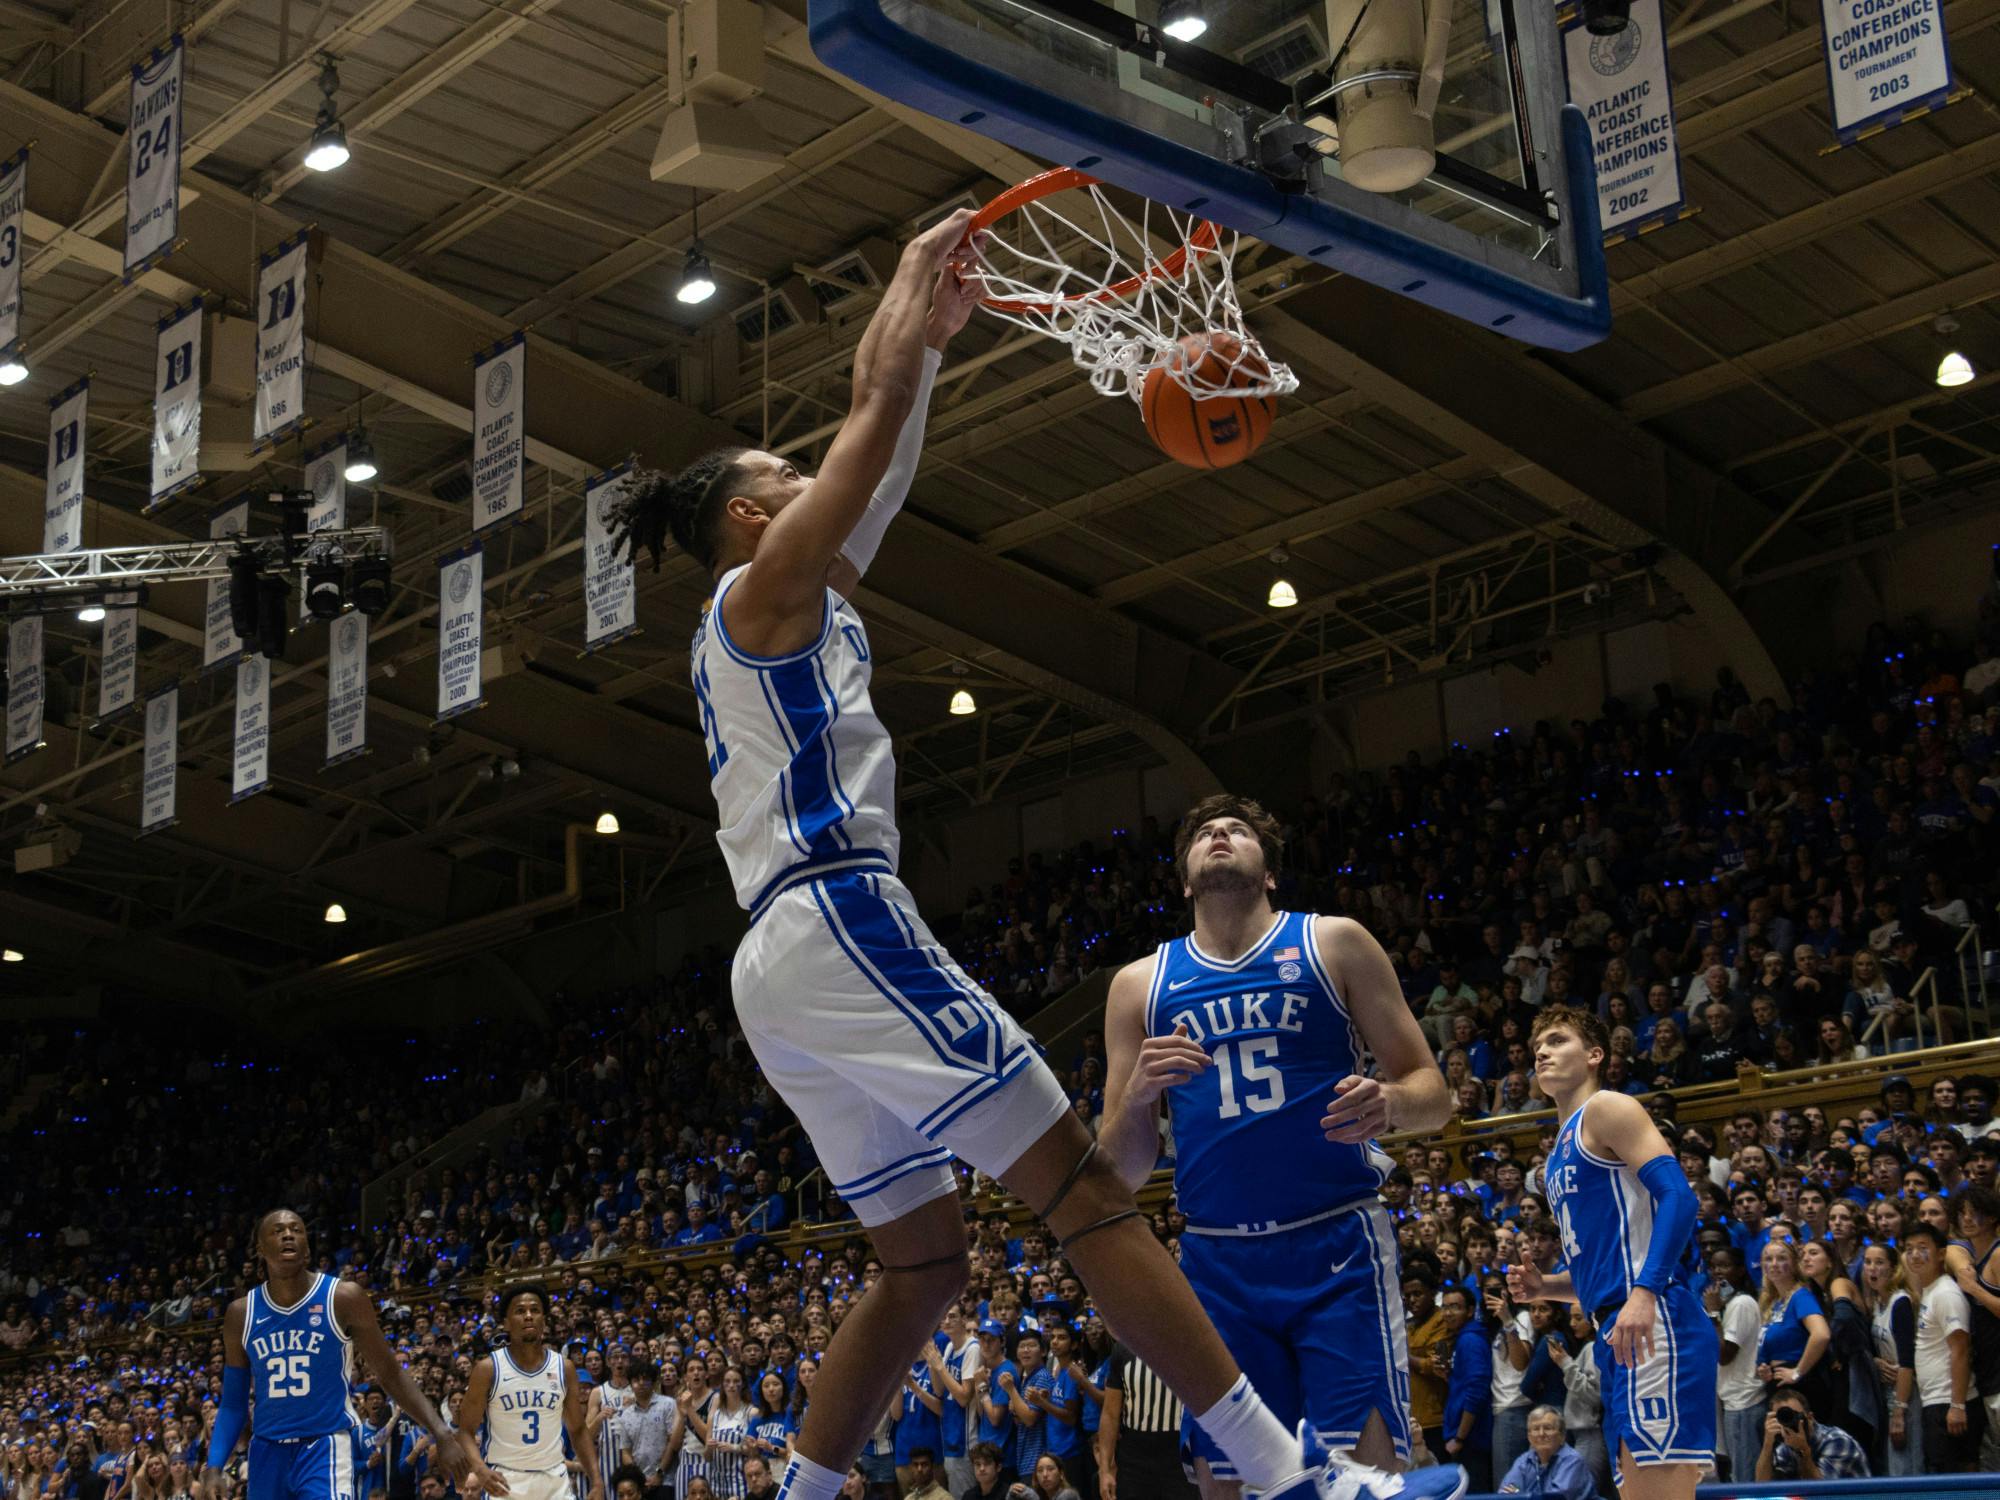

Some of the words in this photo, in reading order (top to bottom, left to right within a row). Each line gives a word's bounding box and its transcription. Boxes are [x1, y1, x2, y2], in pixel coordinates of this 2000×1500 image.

[1852, 0, 1902, 19] COAS
[1831, 0, 1933, 51] CONFERENCE
[1839, 18, 1932, 70] CHAMPIONS
[1854, 47, 1917, 81] TOURNAMENT
[1587, 80, 1651, 120] ATLANTIC
[1869, 74, 1910, 102] 2003
[1598, 104, 1642, 134] COAST
[136, 115, 171, 178] 24
[1593, 114, 1669, 156] NFERENCE
[1600, 165, 1655, 194] TOURNAMENT
[1608, 188, 1649, 216] 2002
[275, 356, 301, 378] FOUR
[481, 411, 514, 439] ATLANTIC
[486, 430, 510, 451] COAST
[474, 438, 521, 473] CONFERENCE
[475, 456, 518, 487] CHAMPIONS
[587, 575, 632, 602] CHAMPIONS
[445, 611, 474, 632] ATLANTIC
[449, 627, 470, 644] COAST
[599, 613, 619, 630] 2001
[441, 637, 479, 661] CONFERENCE
[442, 651, 477, 675] CHAMPIONS
[449, 685, 467, 701] 2000
[1170, 992, 1310, 1044] DUKE
[1211, 1035, 1287, 1120] 15
[1547, 1165, 1579, 1207] UKE
[252, 1329, 326, 1361] DUKE
[265, 1355, 311, 1399] 25
[499, 1390, 561, 1412] DUKE
[521, 1410, 540, 1445] 3
